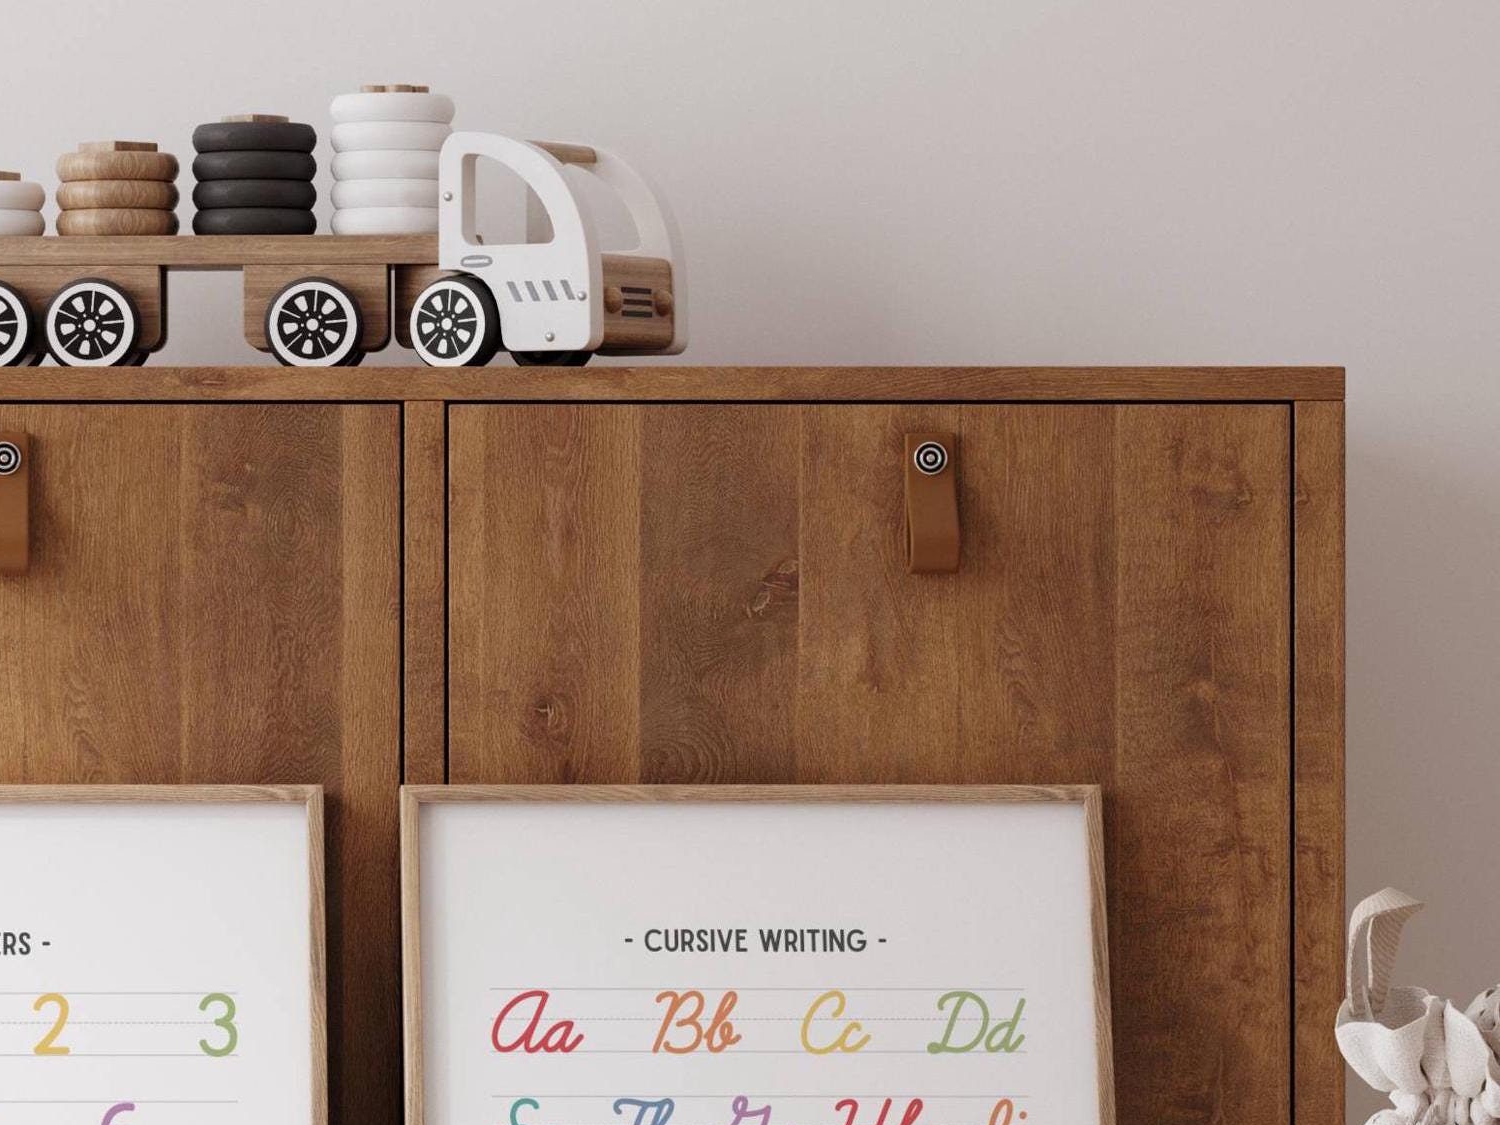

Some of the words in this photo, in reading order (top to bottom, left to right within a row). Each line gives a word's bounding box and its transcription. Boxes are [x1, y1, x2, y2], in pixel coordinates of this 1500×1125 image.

[644, 928, 749, 953] CURSIVE
[758, 928, 868, 953] WRITING
[31, 991, 71, 1057] 2
[199, 992, 239, 1058] 3
[489, 988, 587, 1056] Aa
[651, 986, 742, 1057] Bb
[799, 987, 873, 1057] Cc
[926, 991, 1026, 1055] Dd
